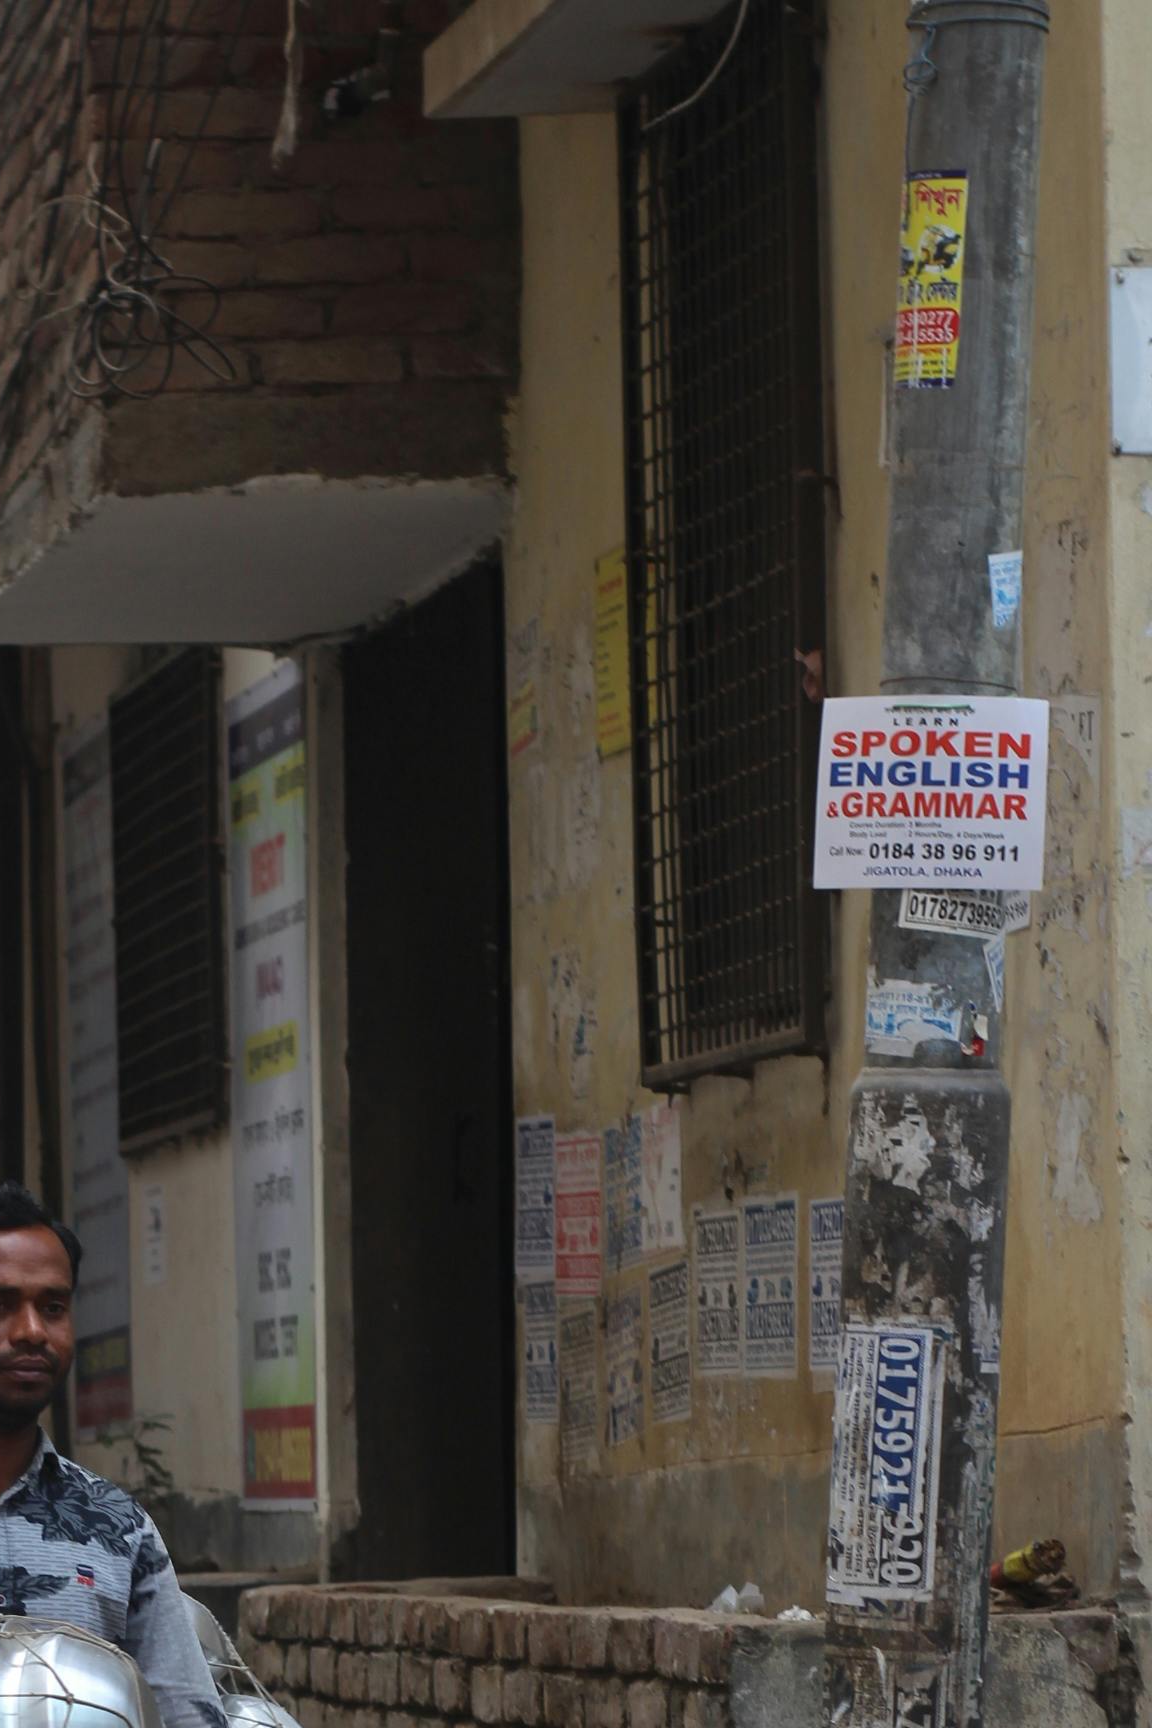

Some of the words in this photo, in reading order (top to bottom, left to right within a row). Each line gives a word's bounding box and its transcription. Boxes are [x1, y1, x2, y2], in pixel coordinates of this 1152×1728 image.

[893, 717, 959, 727] LEARN
[831, 730, 1032, 760] SPOKEN
[829, 761, 1030, 789] ENGLISH
[829, 846, 844, 857] Call
[869, 843, 915, 859] 0184
[921, 843, 946, 860] 38
[952, 844, 977, 861] 96
[983, 845, 1019, 862] 911
[934, 866, 983, 878] DHAKA
